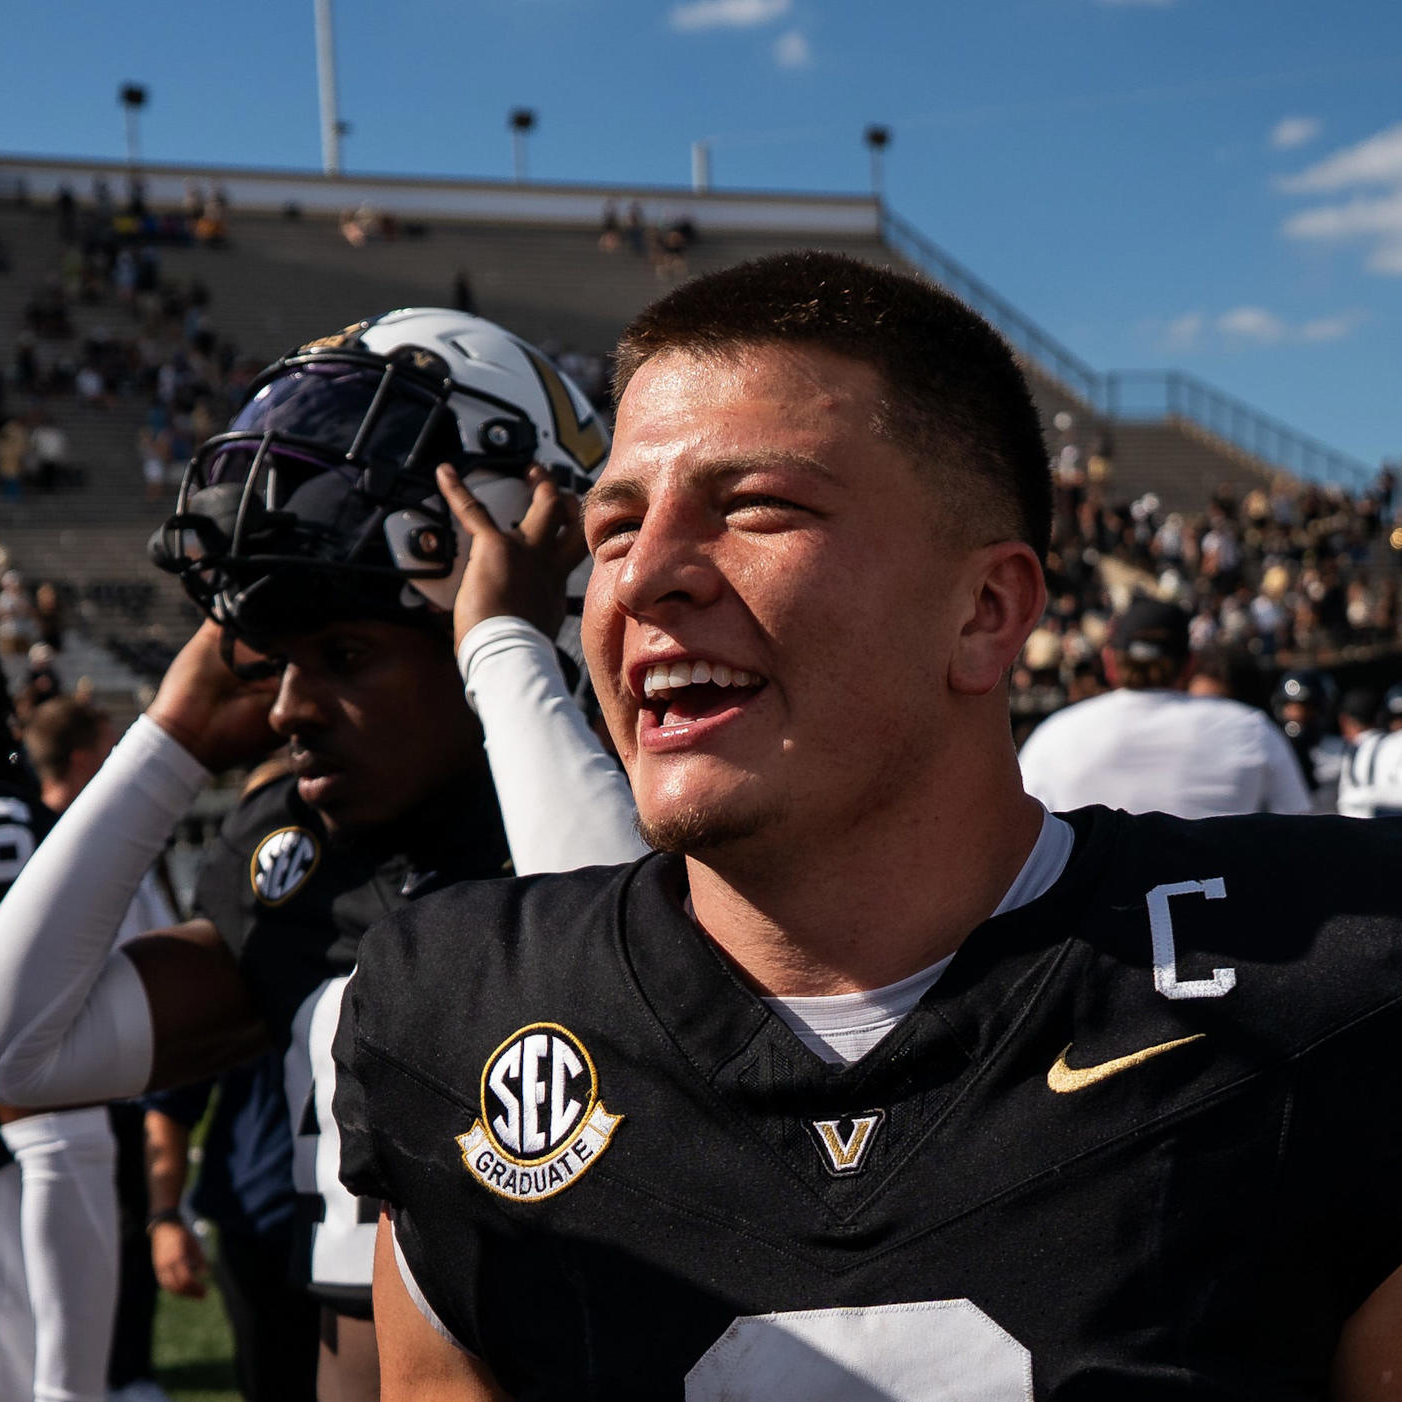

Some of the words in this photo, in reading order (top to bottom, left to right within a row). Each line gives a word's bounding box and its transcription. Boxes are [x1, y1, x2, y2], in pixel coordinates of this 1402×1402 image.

[1145, 877, 1236, 1000] C
[487, 1033, 585, 1154] SEC
[475, 1137, 595, 1196] GRADUATE
[812, 1111, 884, 1177] V
